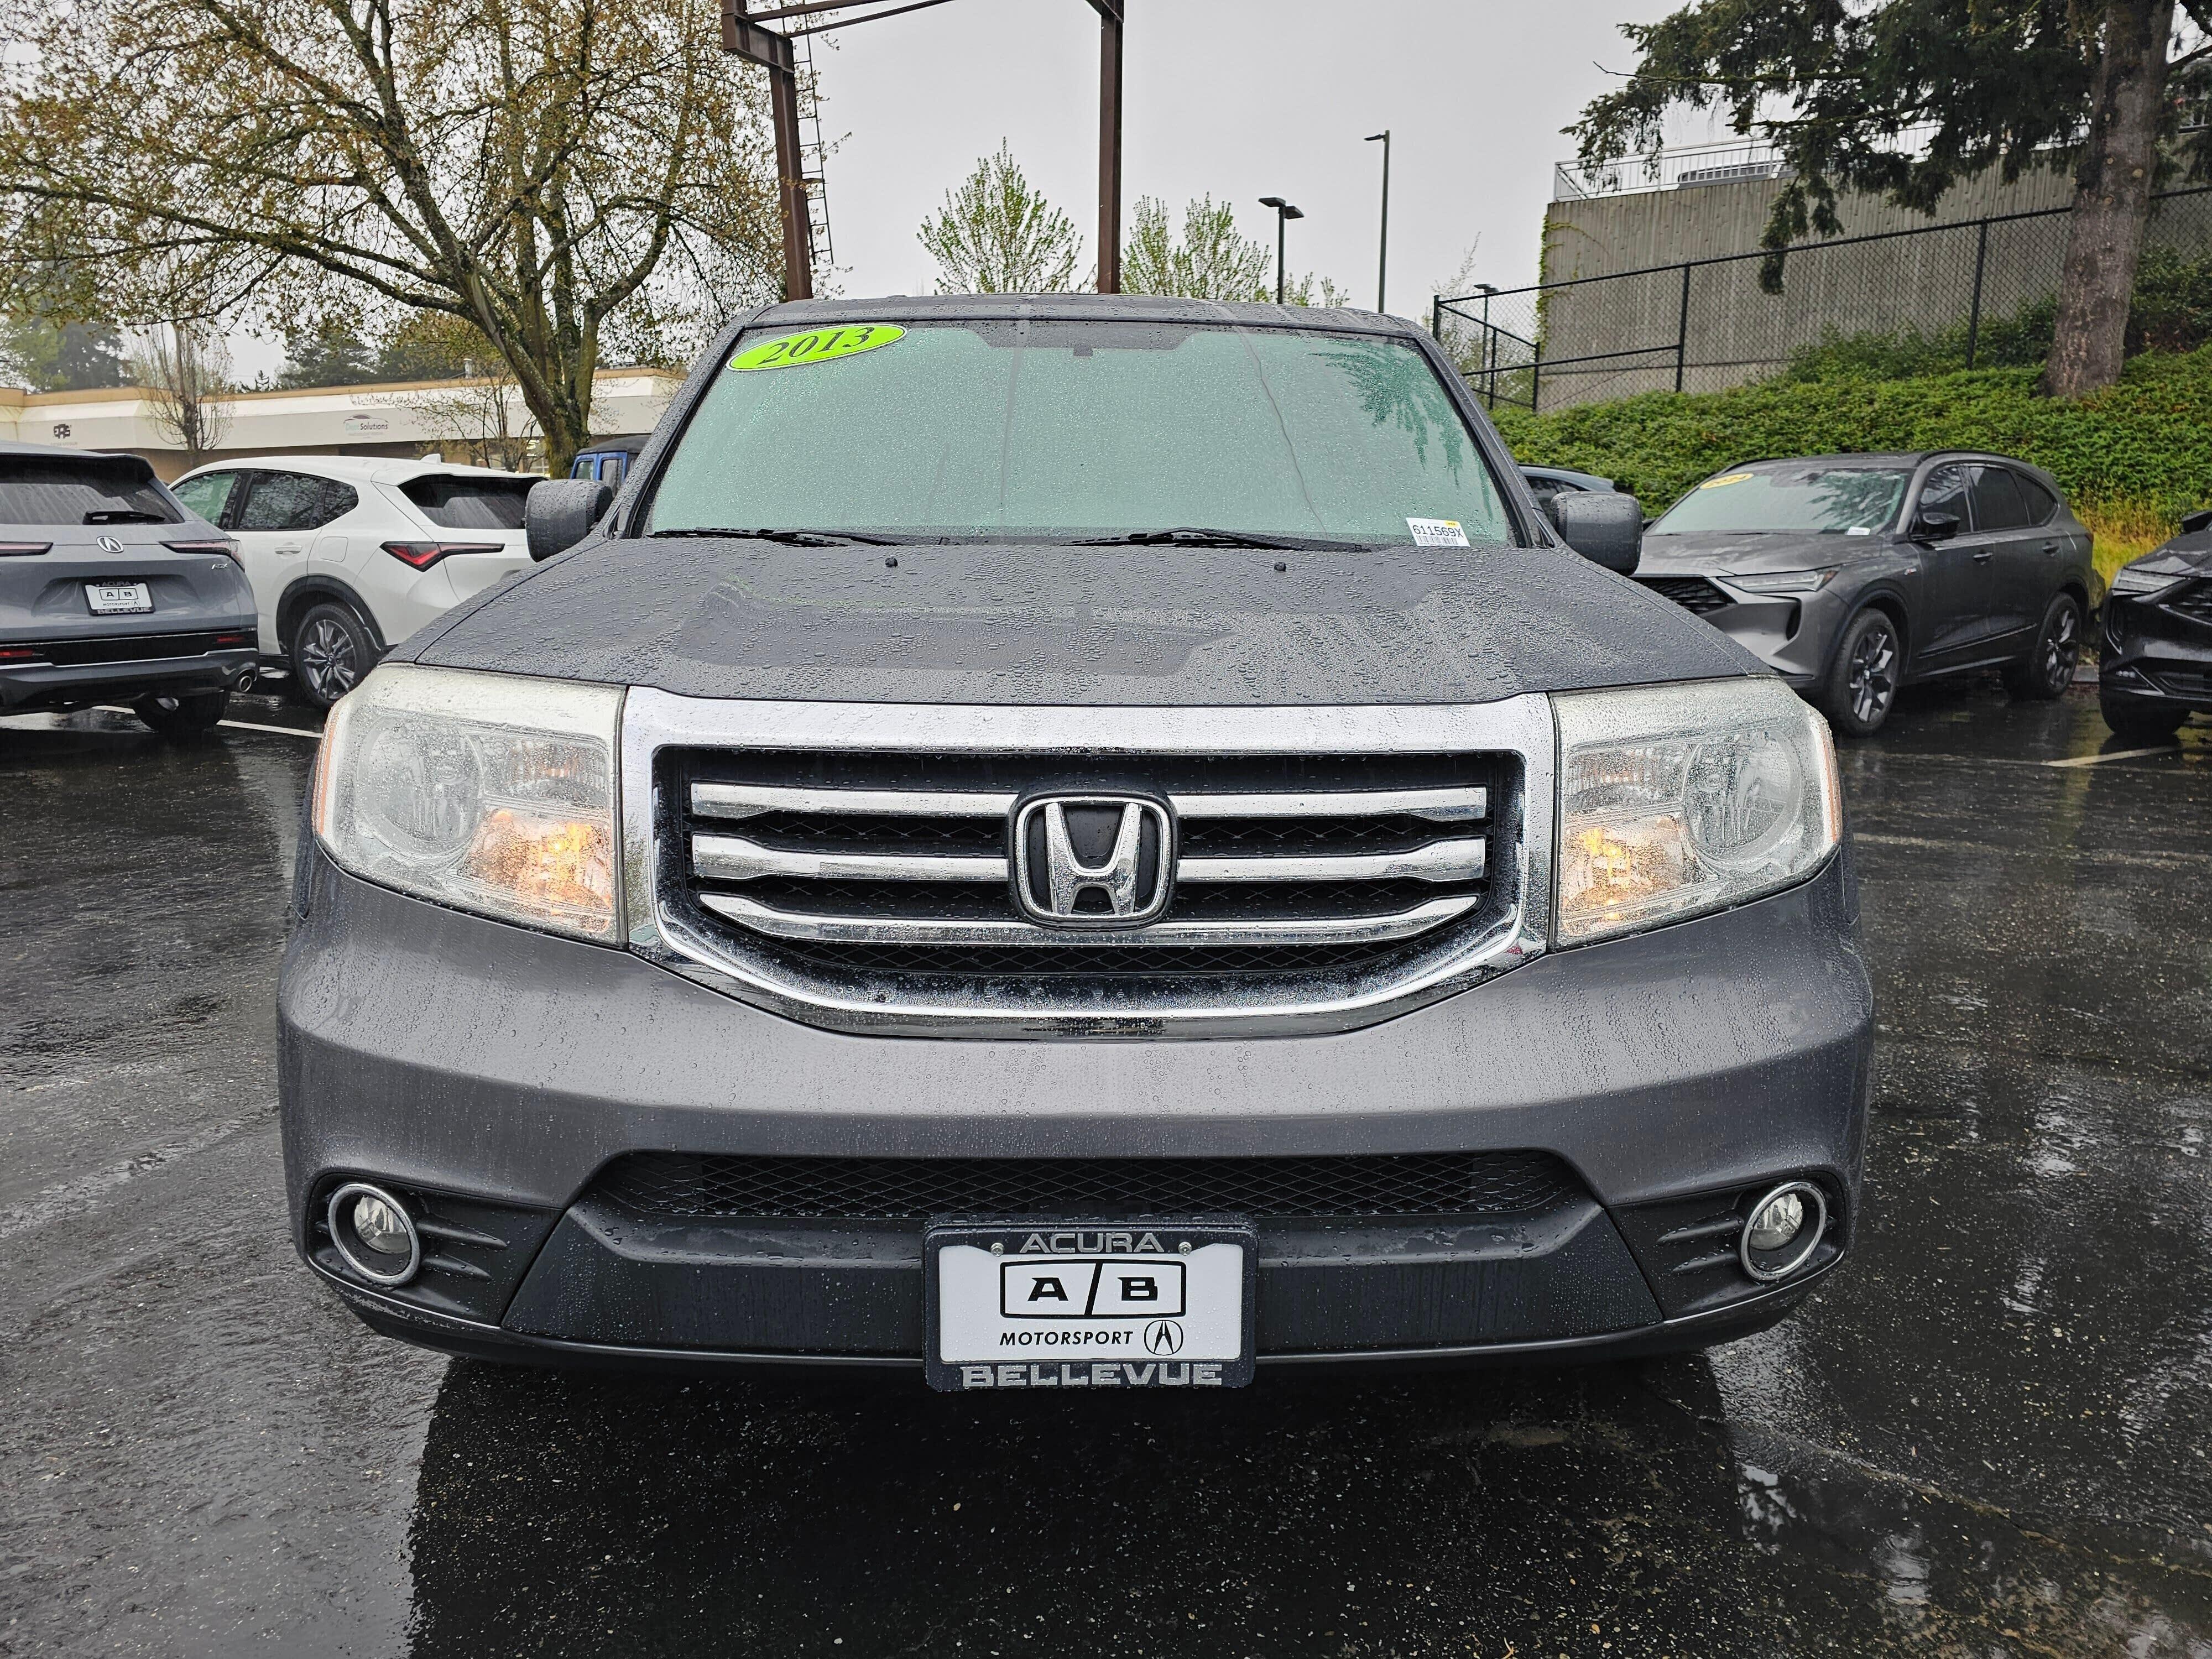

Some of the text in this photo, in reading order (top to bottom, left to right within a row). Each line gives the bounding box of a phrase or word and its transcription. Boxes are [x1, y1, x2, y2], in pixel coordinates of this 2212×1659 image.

[757, 326, 875, 366] 2013
[360, 421, 388, 430] Solutions
[1412, 525, 1464, 538] 611569X
[1019, 1232, 1165, 1254] ACURA
[999, 1331, 1134, 1347] MOTORSPORT
[960, 1363, 1223, 1389] BELLEVUE
